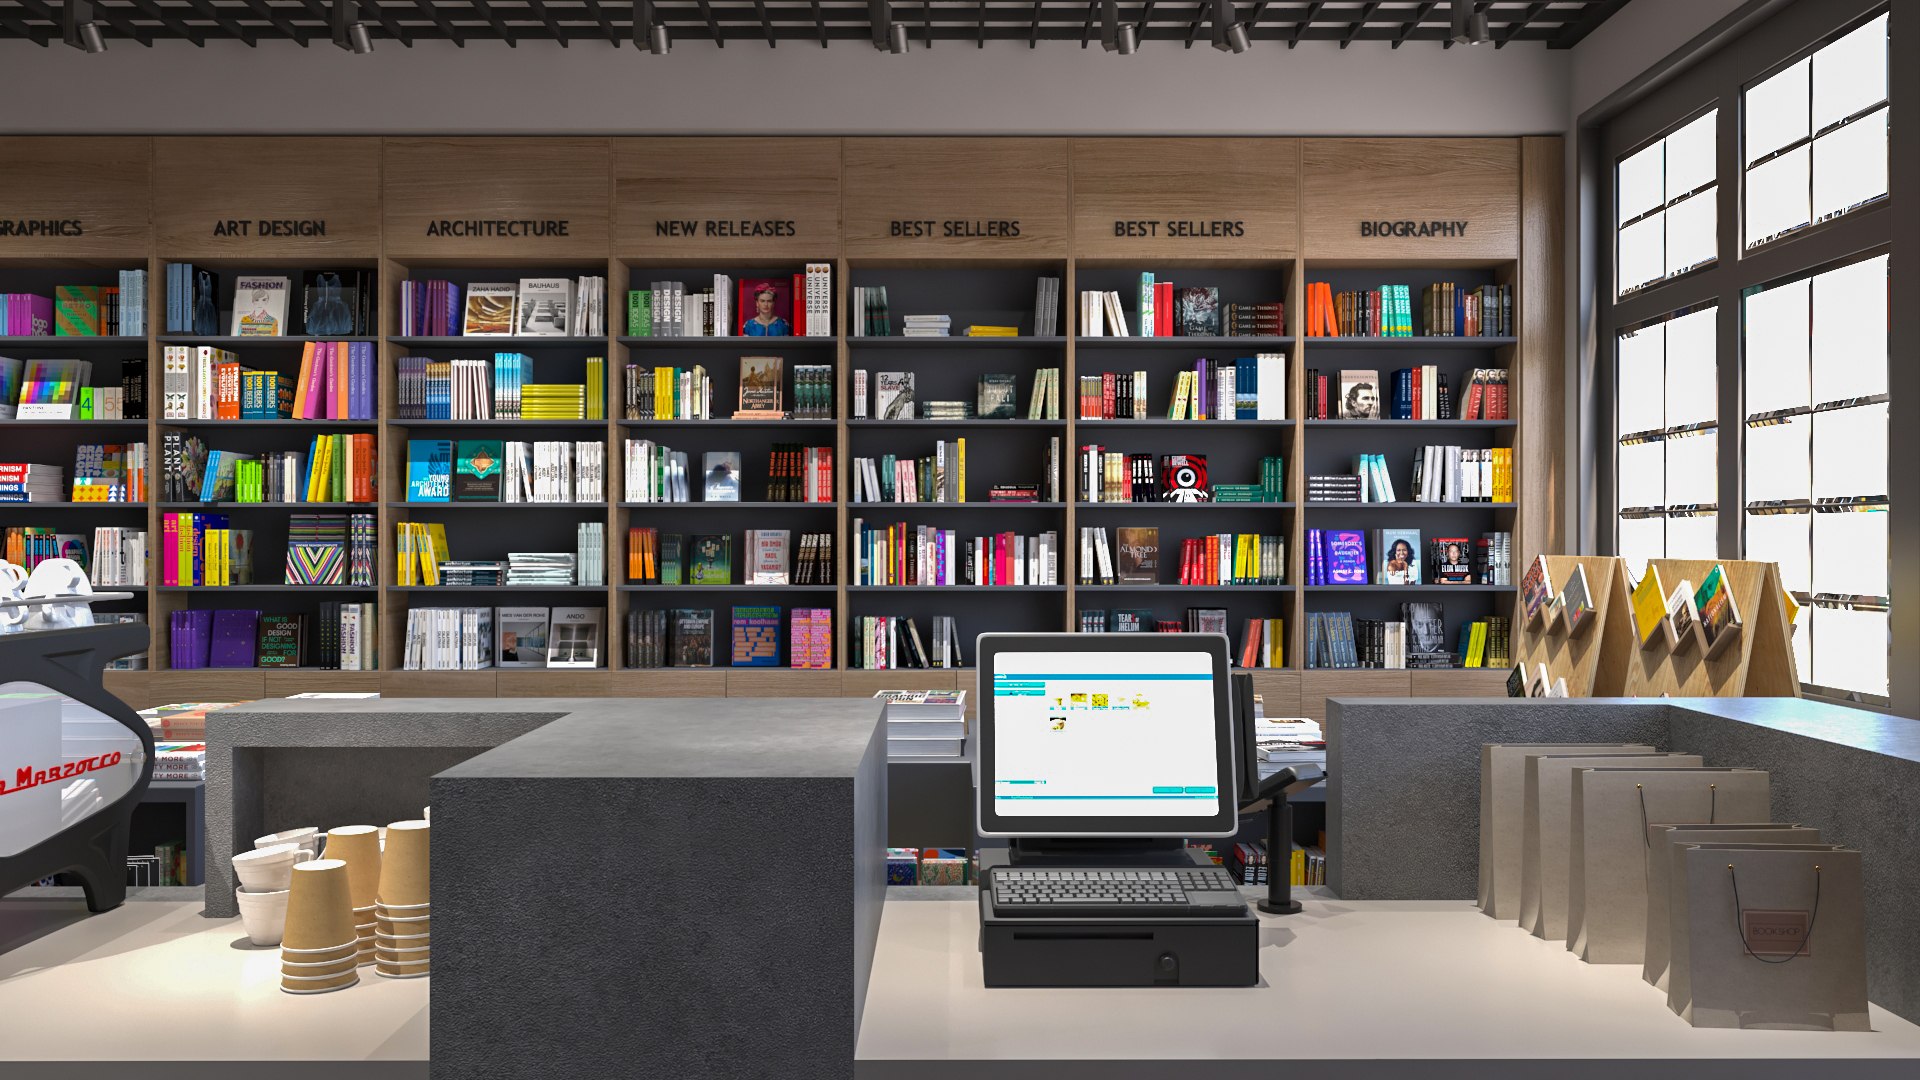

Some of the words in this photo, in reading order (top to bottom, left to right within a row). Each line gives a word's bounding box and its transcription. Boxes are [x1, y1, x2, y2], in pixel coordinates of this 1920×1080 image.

[214, 221, 251, 236] ART
[259, 221, 326, 236] DESIGN
[427, 221, 569, 236] ARCHITECTURE
[656, 221, 698, 236] NEW
[706, 221, 796, 236] RELEASES
[890, 221, 936, 236] BEST
[943, 221, 1020, 236] SELLERS
[1115, 221, 1160, 236] BEST
[1167, 221, 1244, 236] SELLERS
[1361, 221, 1467, 236] BIOGRAPHY
[240, 281, 283, 289] FASHION
[663, 290, 671, 323] DESIGN
[674, 290, 682, 323] DESIGN
[82, 397, 92, 412] 4
[104, 397, 115, 412] 5
[1472, 387, 1482, 413] GRANT
[172, 436, 181, 472] PLANT
[429, 474, 450, 482] YOUNG
[418, 487, 449, 497] AWARD
[1441, 564, 1454, 572] ELON
[1454, 564, 1469, 572] MUSK
[276, 622, 297, 630] GOOD
[1118, 622, 1140, 631] JHELUM
[1245, 866, 1255, 882] ELON
[1257, 866, 1267, 882] ELON
